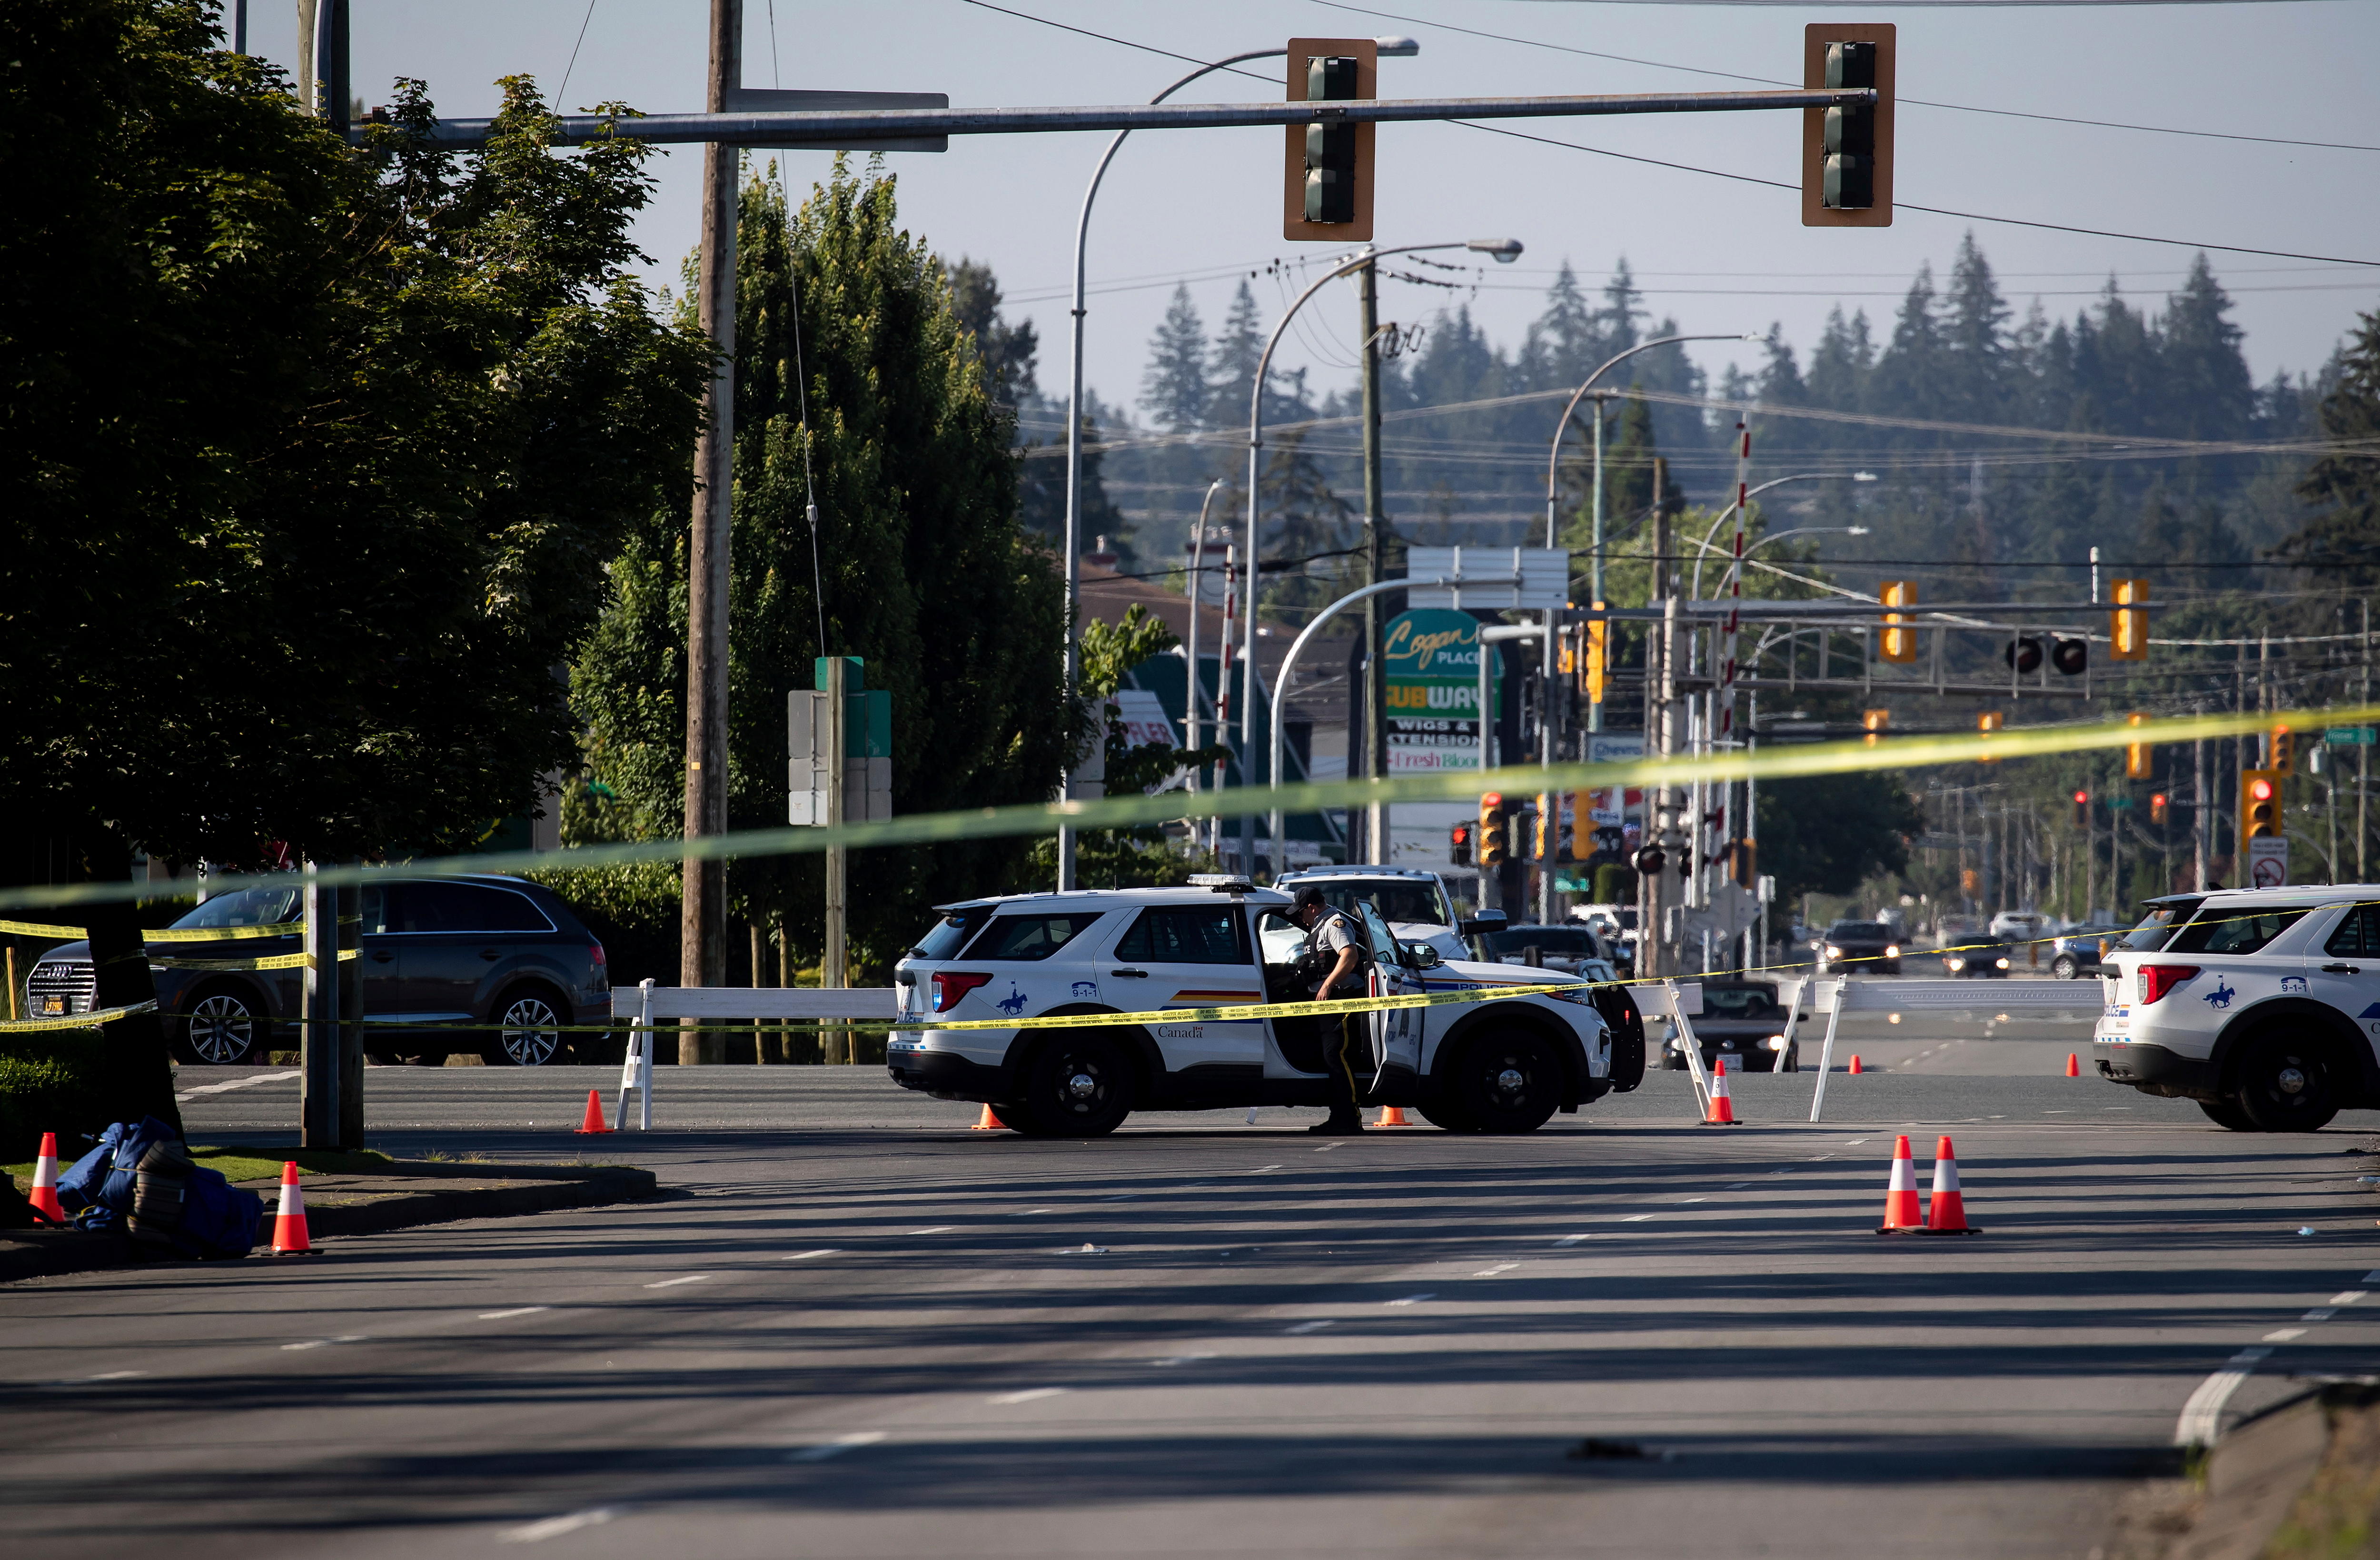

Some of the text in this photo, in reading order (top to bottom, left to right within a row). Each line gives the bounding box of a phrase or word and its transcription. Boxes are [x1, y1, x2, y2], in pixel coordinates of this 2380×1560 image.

[1395, 719, 1470, 732] WIGS &
[1072, 989, 1097, 997] 9-1-1
[2281, 984, 2307, 992] 9-1-1
[1158, 1025, 1202, 1038] Canada
